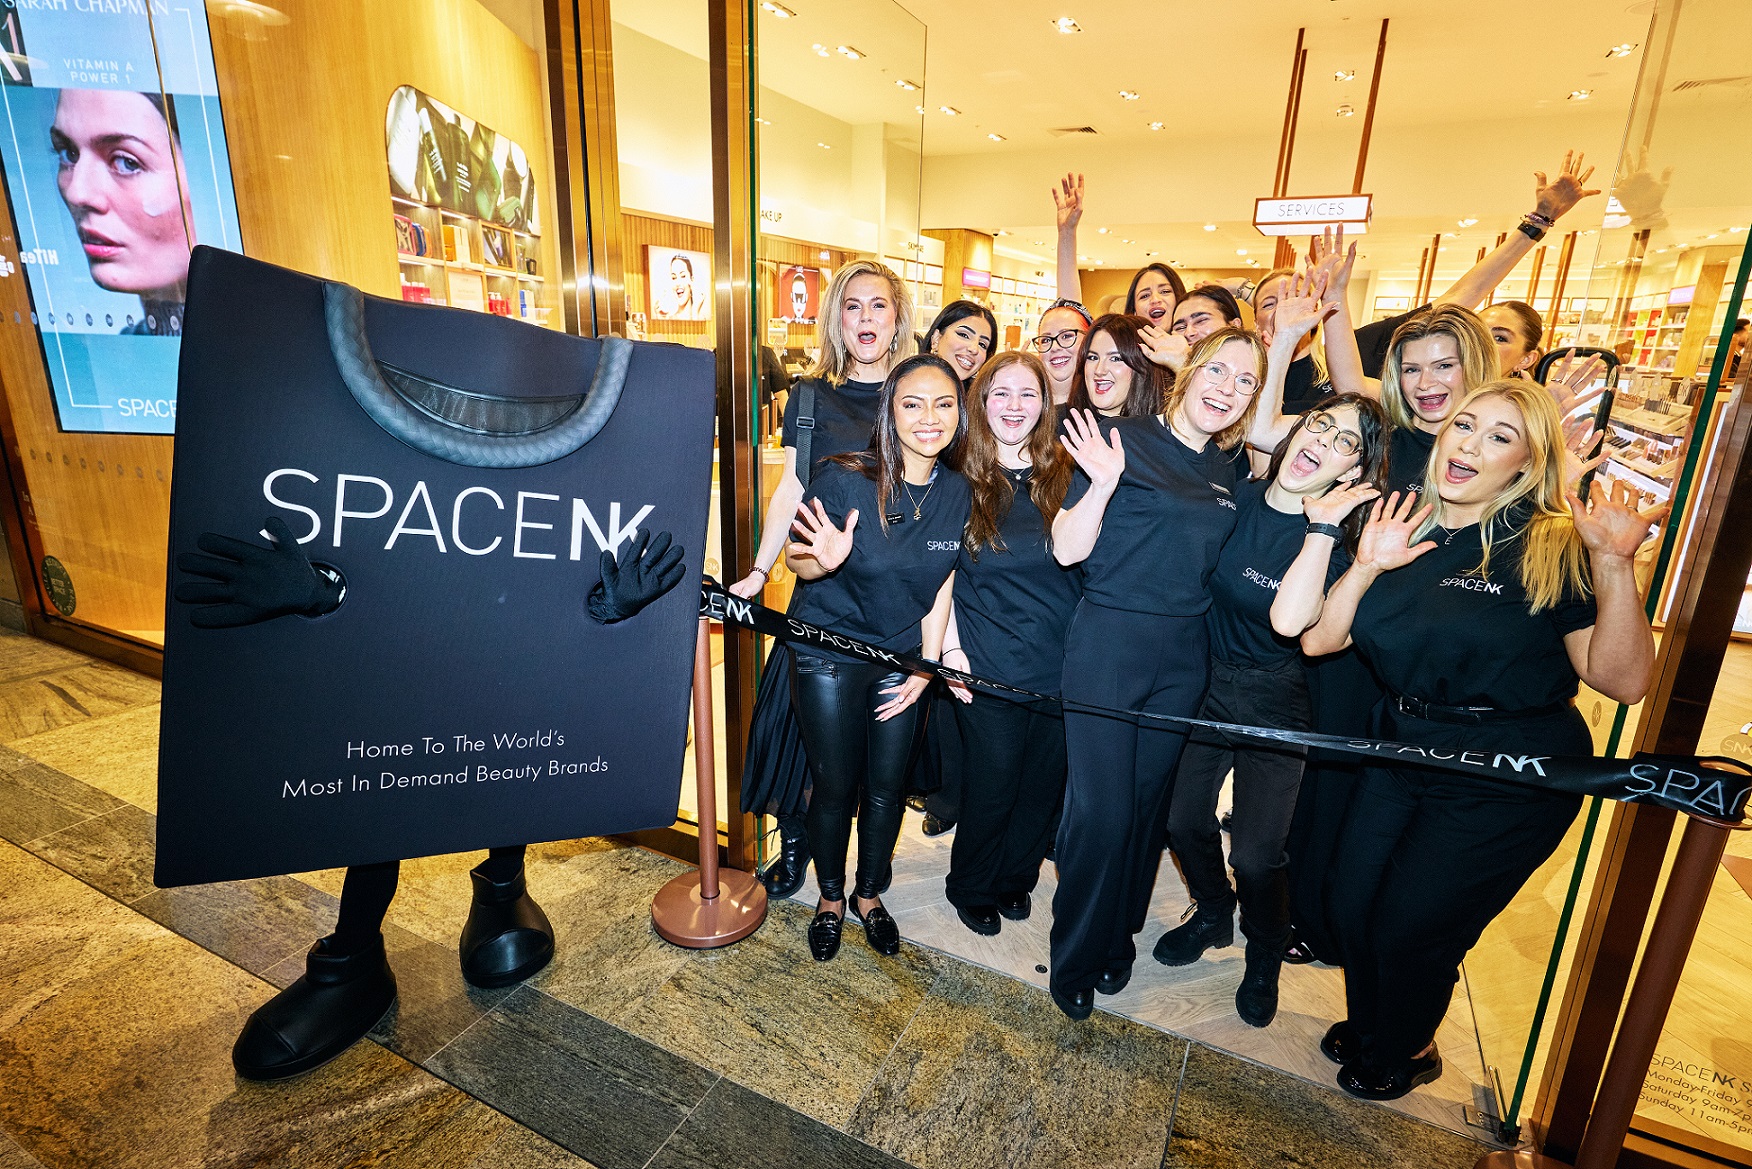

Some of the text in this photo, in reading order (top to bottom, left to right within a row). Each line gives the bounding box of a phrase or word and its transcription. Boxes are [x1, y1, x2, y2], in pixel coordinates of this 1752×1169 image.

[76, 0, 169, 15] CHAPMAN
[63, 58, 134, 72] VITAMIN A
[70, 71, 131, 84] POWER 1
[1277, 202, 1345, 217] SERVICES
[1439, 578, 1504, 595] SPACENK
[787, 618, 902, 666] SPACENK
[347, 740, 413, 759] Home
[422, 737, 445, 754] To
[453, 734, 485, 752] The
[282, 756, 608, 798] Most In Demand Beauty Brands
[1650, 1053, 1736, 1089] SPACENK
[1639, 1091, 1684, 1114] Sunday
[1641, 1080, 1697, 1104] Saturday
